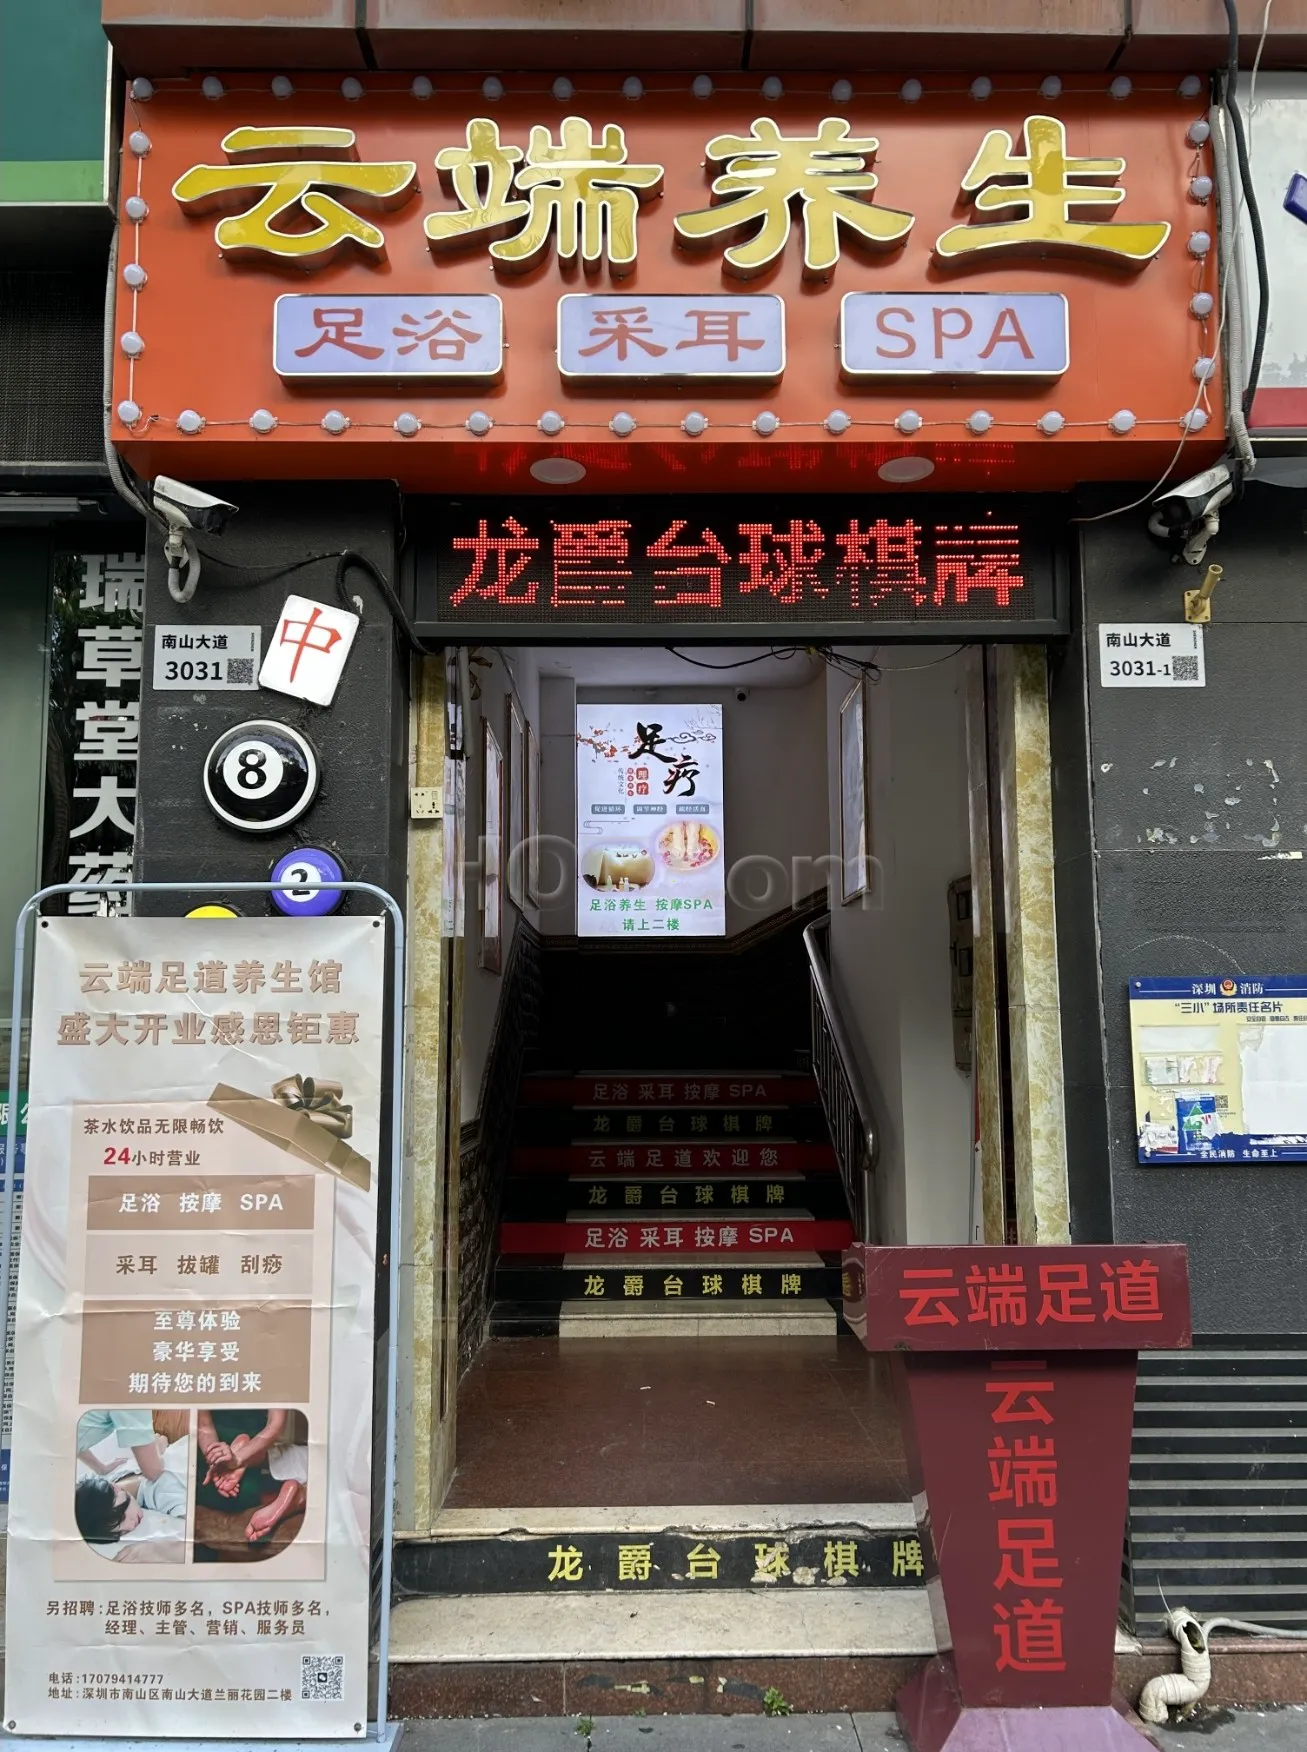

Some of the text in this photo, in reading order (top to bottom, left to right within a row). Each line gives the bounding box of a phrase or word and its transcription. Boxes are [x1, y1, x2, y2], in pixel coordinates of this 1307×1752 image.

[171, 115, 1171, 271] 云端养生
[294, 306, 1035, 362] 足浴 采耳 SPA
[161, 634, 229, 650] 南山大道
[279, 606, 343, 683] 中
[1106, 632, 1171, 648] 南山大道
[164, 660, 223, 681] 3031
[1110, 660, 1172, 677] 3031-1
[236, 748, 267, 790] 8
[628, 721, 700, 797] 足疗
[289, 868, 312, 897] 2
[589, 898, 713, 912] 足浴养生 按摩SPA
[622, 917, 680, 932] 请上二楼
[79, 959, 343, 995] 云端足道养生馆
[1191, 982, 1263, 996] 深圳 消防
[57, 1011, 360, 1046] 盛大开业感恩钜惠
[592, 1083, 767, 1101] 足浴 采耳 按摩 SPA
[83, 1117, 225, 1136] 茶水饮品无限畅饮
[593, 1114, 773, 1132] 龙爵台球棋牌
[103, 1146, 201, 1167] 24小时营业
[588, 1148, 779, 1168] 云端足道欢迎您
[1200, 1148, 1279, 1159] 全民消防 生命至上
[118, 1191, 284, 1213] 足浴 按摩 SPA
[588, 1184, 785, 1205] 龙爵台球棋牌
[584, 1226, 794, 1249] 足浴 采耳 按摩 SPA
[116, 1253, 283, 1276] 采耳 拔罐 刮痧
[584, 1274, 802, 1296] 龙爵台球棋牌
[900, 1260, 1164, 1328] 云端足道
[153, 1310, 241, 1331] 至尊体验
[152, 1340, 240, 1362] 豪华享受
[128, 1371, 262, 1394] 期待您的到来
[985, 1360, 1067, 1673] 云端足道
[104, 1620, 306, 1636] 经理、主管、营销、服务员
